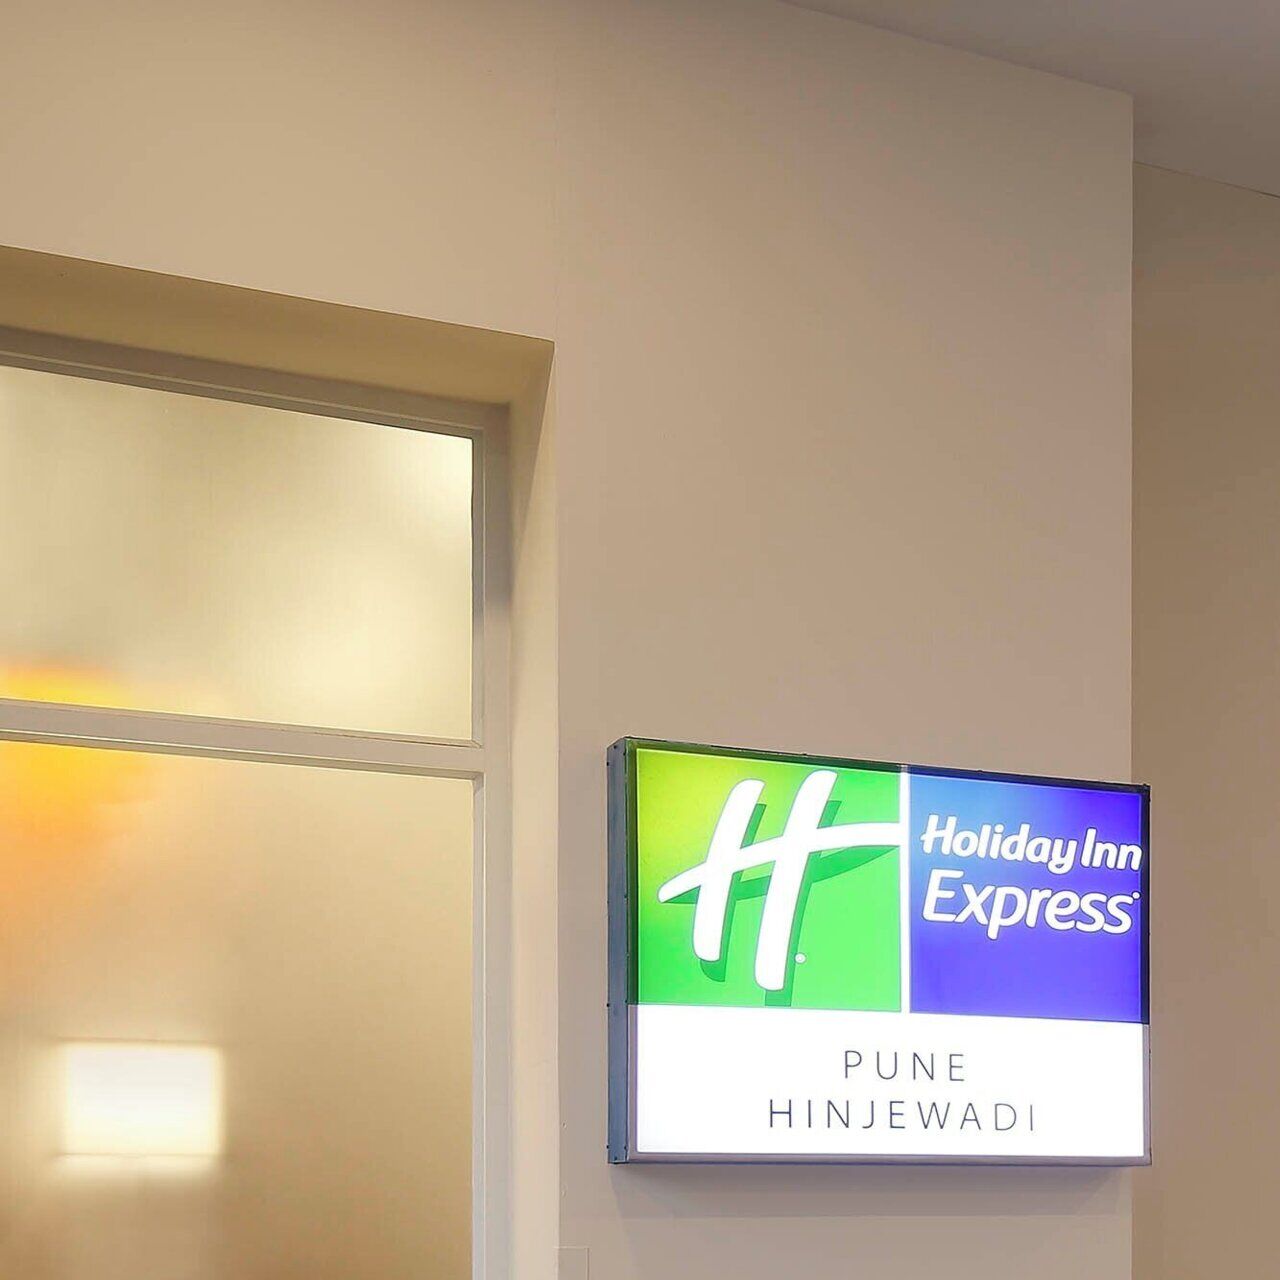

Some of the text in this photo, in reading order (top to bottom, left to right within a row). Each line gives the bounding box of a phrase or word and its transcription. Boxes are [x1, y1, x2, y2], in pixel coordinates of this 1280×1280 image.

[919, 813, 1143, 875] Holiday Inn
[921, 867, 1134, 941] Express
[843, 1049, 966, 1082] PUNE
[768, 1098, 1035, 1132] HINJEWADI
